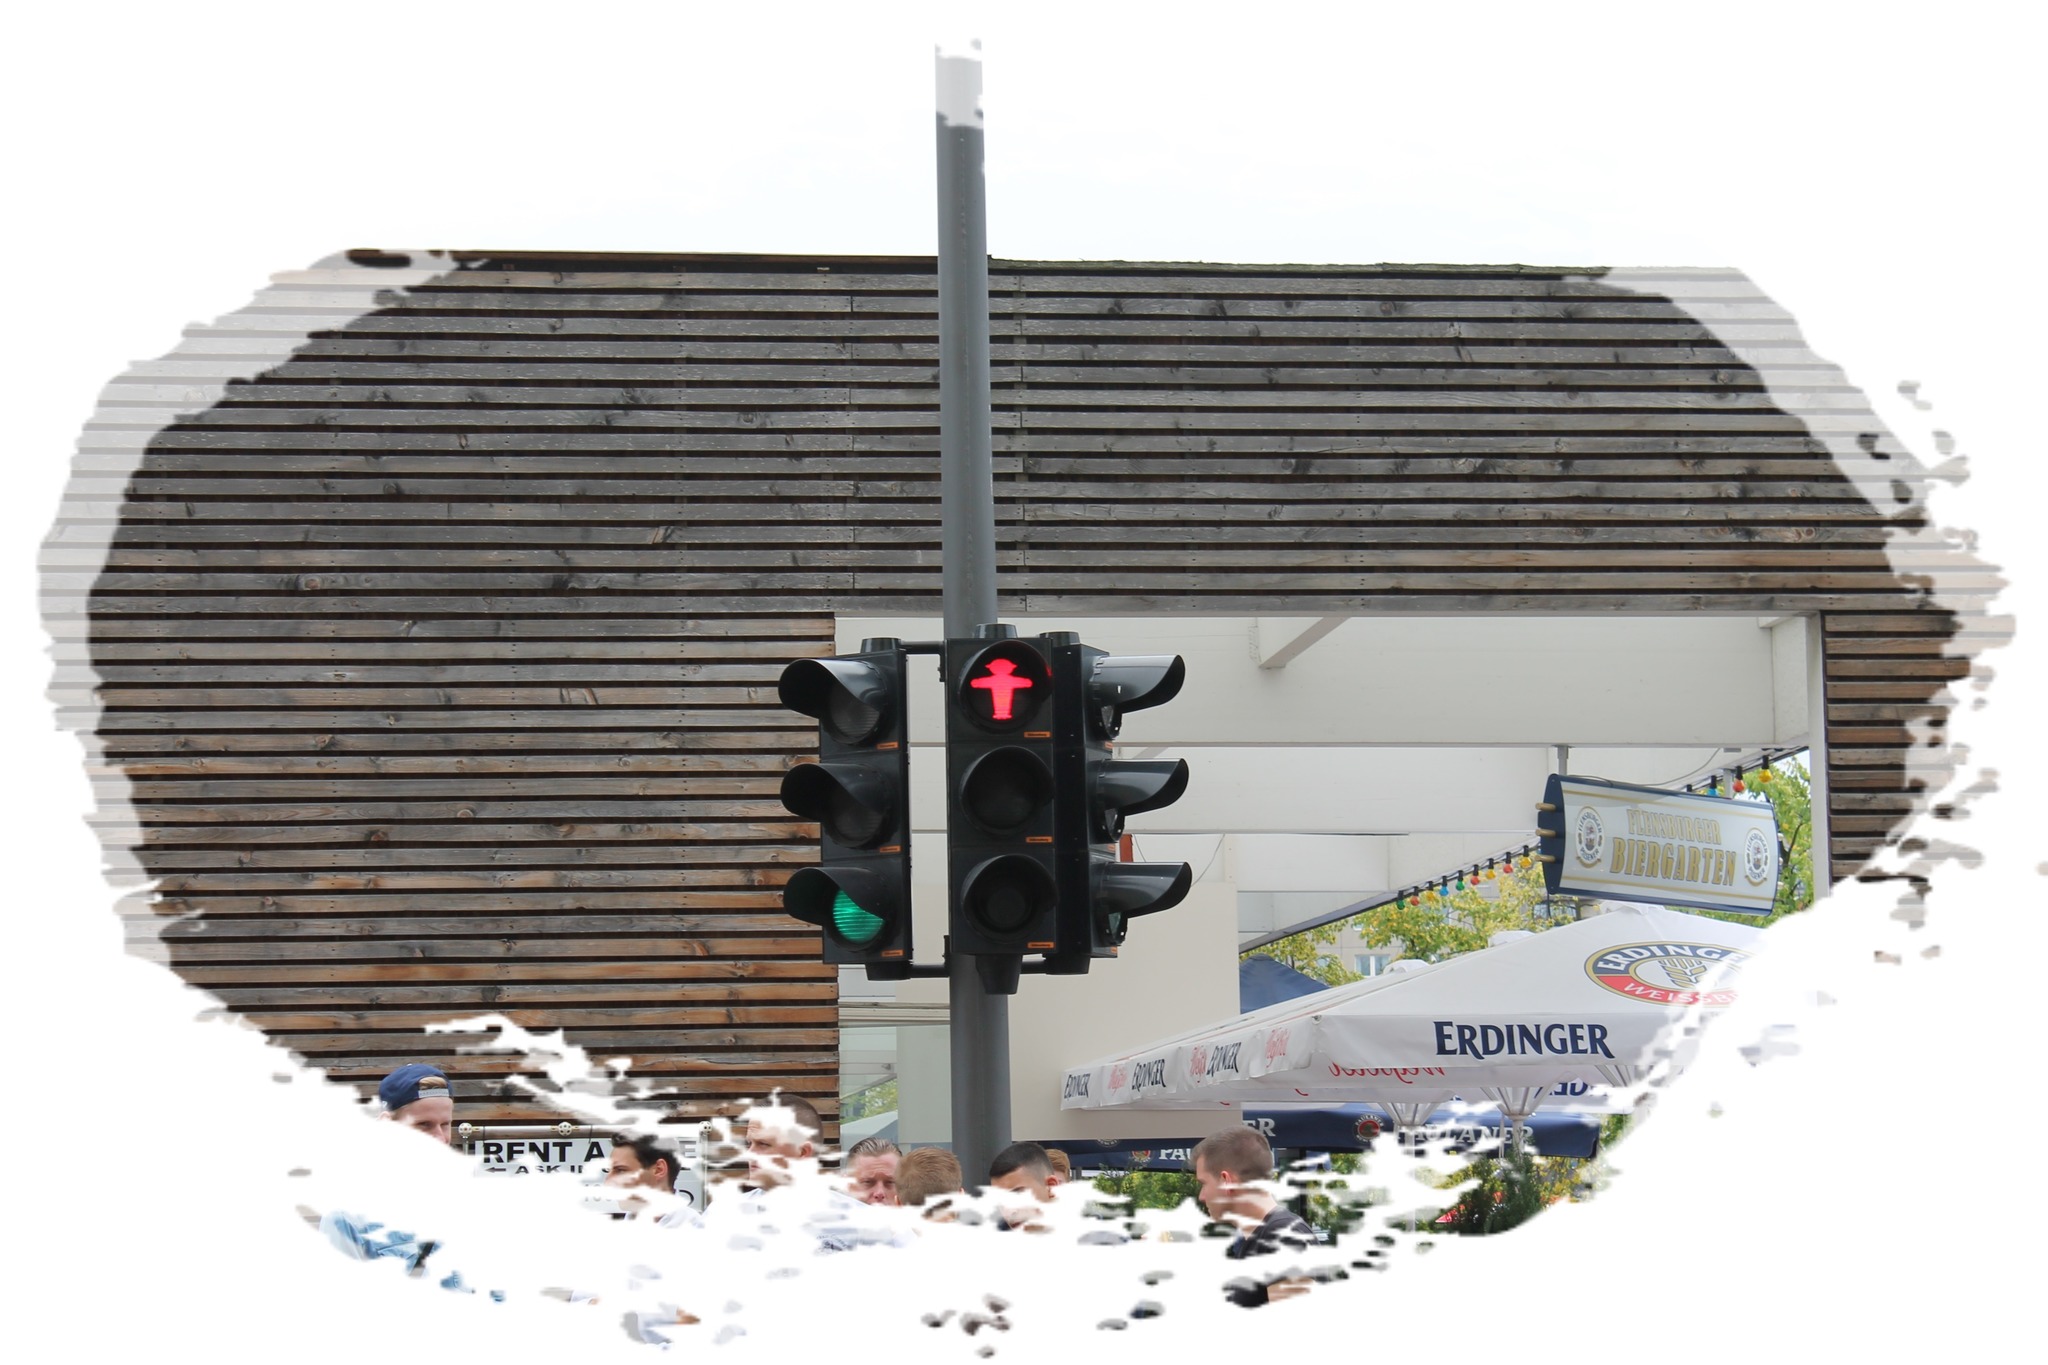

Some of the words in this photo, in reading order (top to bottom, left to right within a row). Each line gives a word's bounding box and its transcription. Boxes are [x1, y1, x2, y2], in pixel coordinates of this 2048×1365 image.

[1626, 808, 1722, 845] FLENSBURGER
[1610, 836, 1736, 886] BIERGARTEN
[1433, 1020, 1615, 1060] ERDINGER
[483, 1141, 573, 1163] RENT
[583, 1141, 605, 1162] A
